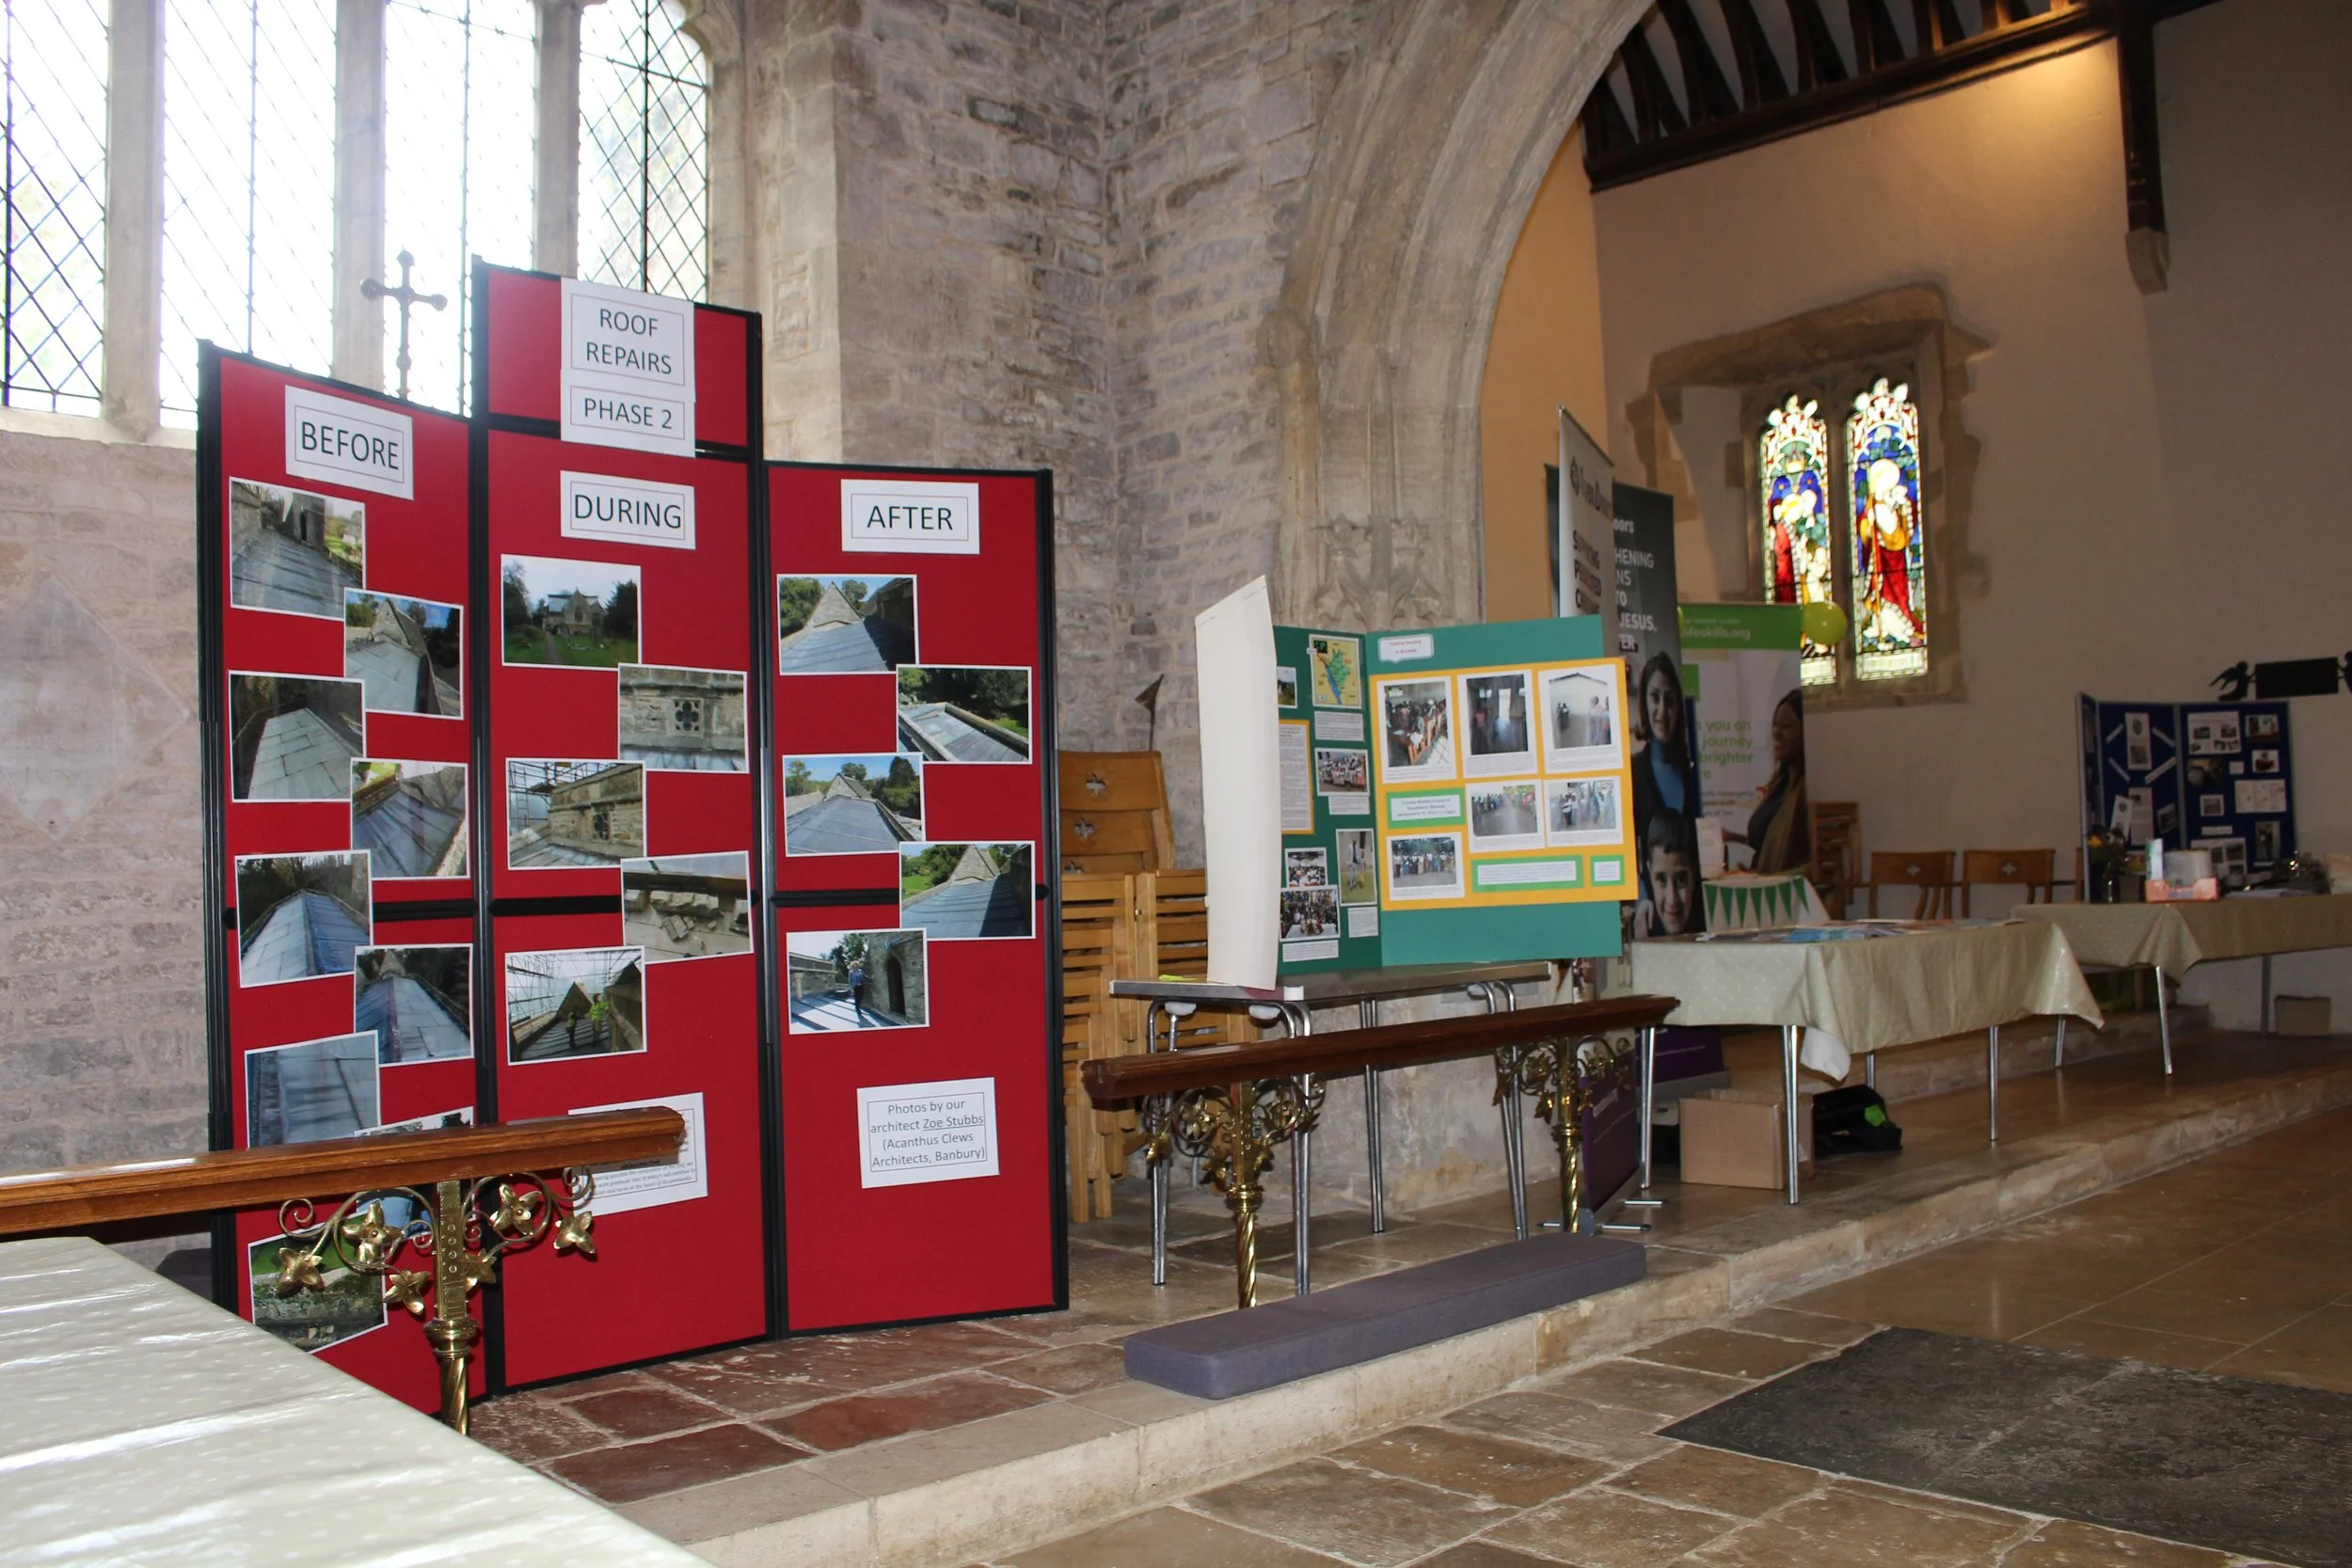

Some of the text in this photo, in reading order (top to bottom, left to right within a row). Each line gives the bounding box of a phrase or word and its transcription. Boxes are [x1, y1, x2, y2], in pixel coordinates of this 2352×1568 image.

[599, 308, 660, 337] ROOF
[585, 341, 673, 374] REPAIRS
[583, 397, 673, 430] PHASE 2
[301, 420, 400, 471] BEFORE
[574, 494, 682, 530] DURING
[866, 505, 954, 531] AFTER
[1613, 518, 1635, 533] oors
[1613, 547, 1655, 569] HENING
[1615, 569, 1632, 587] NS
[1707, 721, 1731, 733] you
[1735, 721, 1751, 732] on
[1702, 736, 1754, 750] journey
[1697, 752, 1754, 767] brighter
[887, 1101, 965, 1115] Photos by our
[870, 1114, 984, 1133] architect Zoe Stubbs
[882, 1132, 975, 1151] (Acanthus Clews
[872, 1146, 985, 1167] Architects, Banbury)
